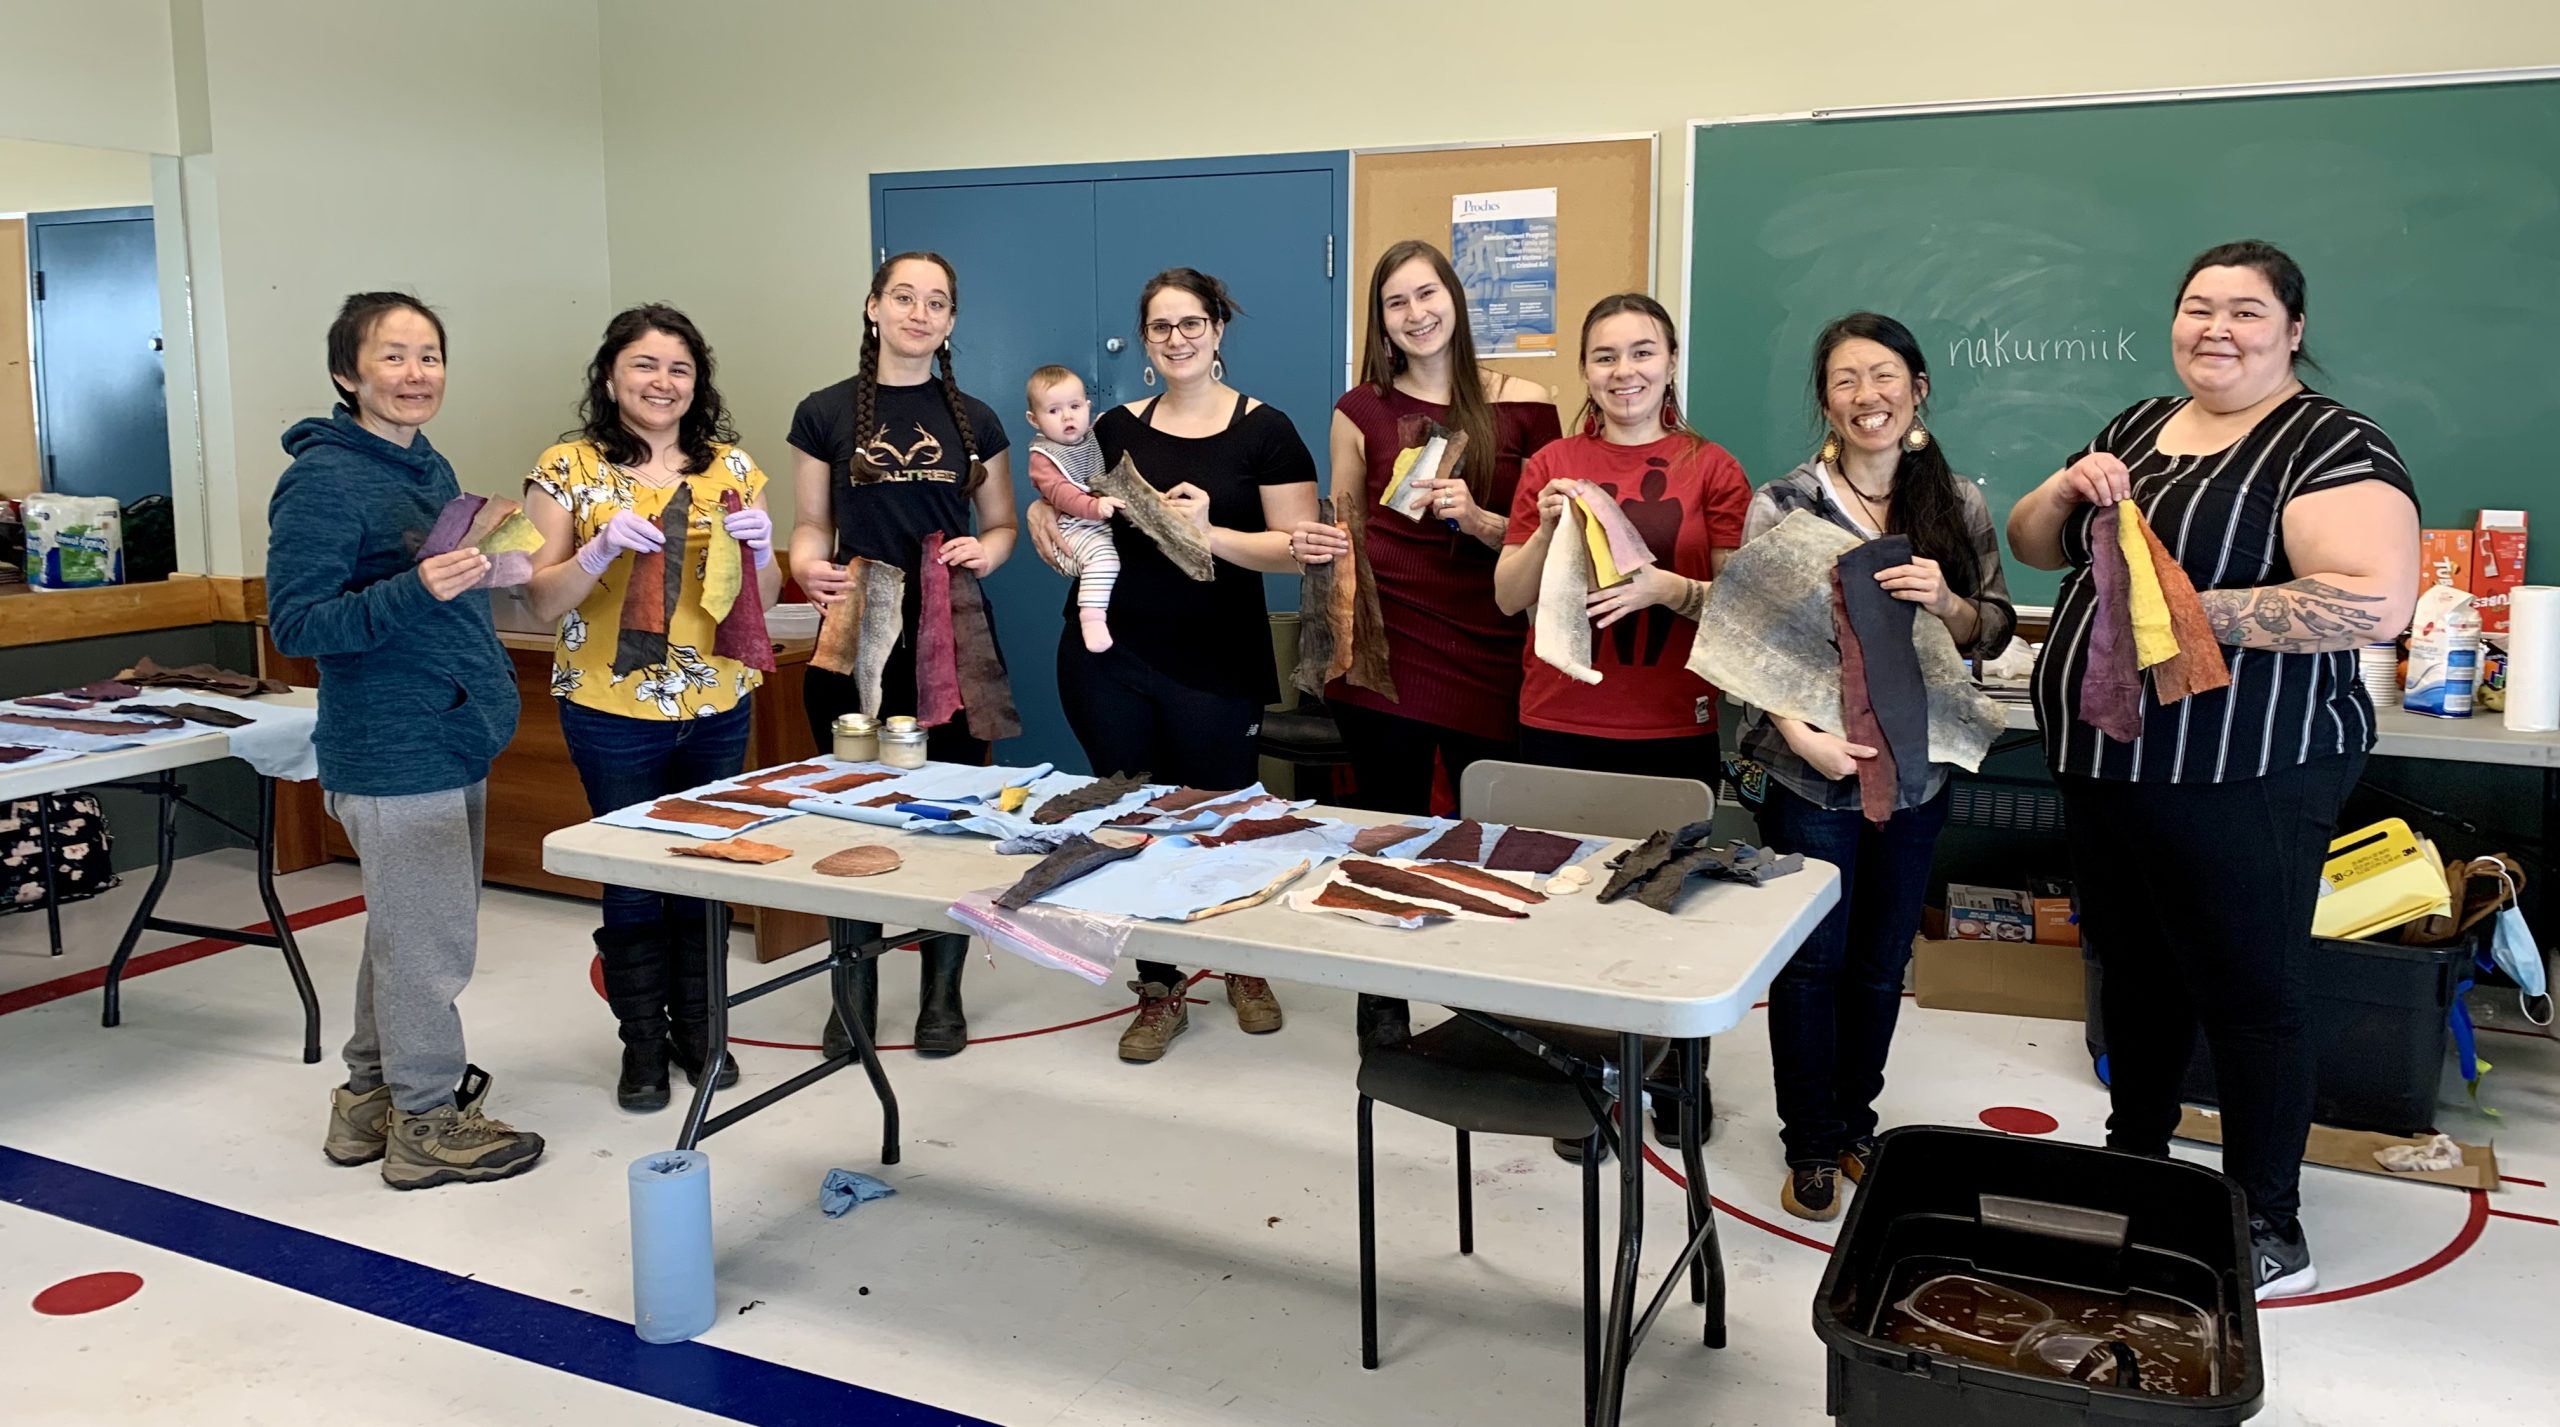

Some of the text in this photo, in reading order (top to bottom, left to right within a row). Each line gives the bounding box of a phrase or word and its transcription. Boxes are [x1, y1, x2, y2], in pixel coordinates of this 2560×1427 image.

[1464, 199, 1500, 213] Proches
[1950, 327, 2138, 368] nakurmiik
[850, 468, 957, 487] ALTREE
[2402, 846, 2417, 857] 3M
[2331, 873, 2343, 883] 30
